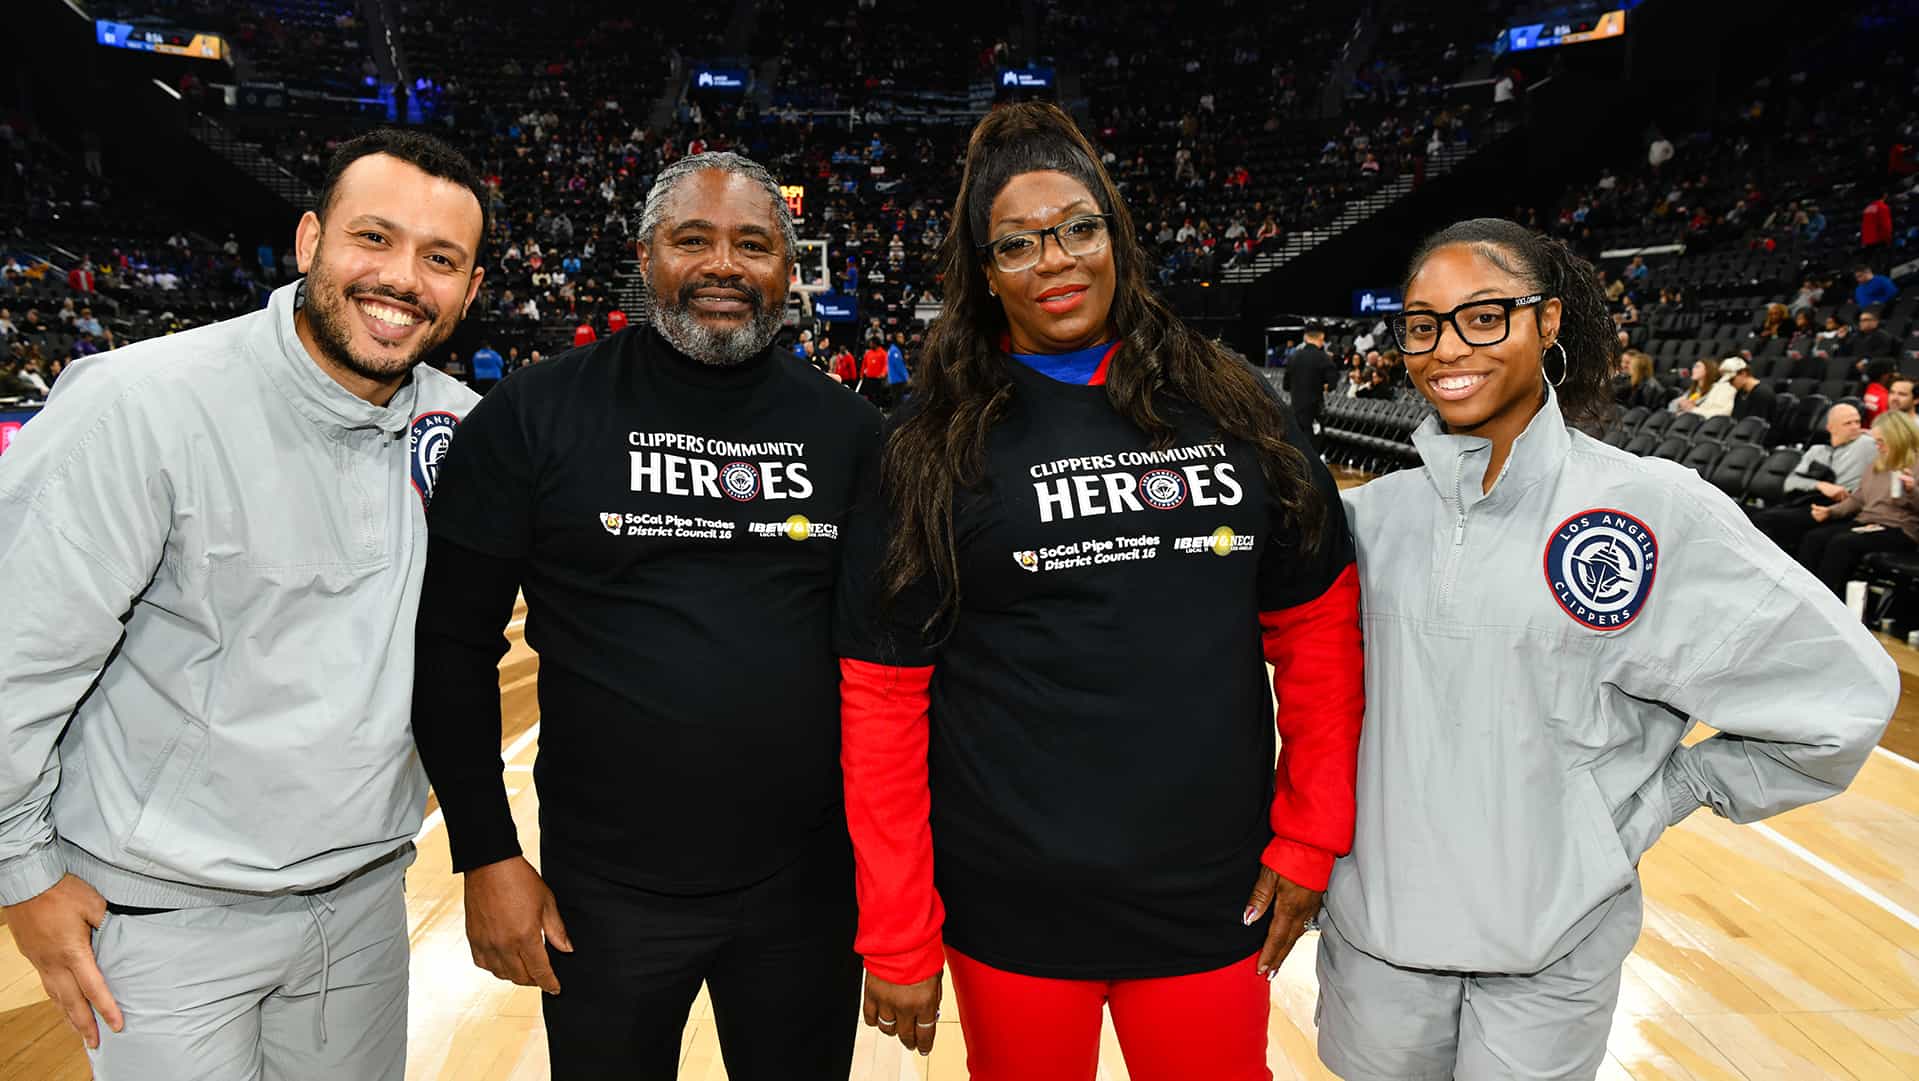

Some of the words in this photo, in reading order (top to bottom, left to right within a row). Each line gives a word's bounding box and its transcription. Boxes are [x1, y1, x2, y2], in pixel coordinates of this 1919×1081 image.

[628, 431, 704, 453] CLIPPERS
[707, 439, 804, 457] COMMUNITY
[1029, 454, 1116, 478] CLIPPERS
[1118, 443, 1227, 465] COMMUNITY
[628, 451, 814, 502] HEROES
[1033, 462, 1243, 523] HEROES
[625, 513, 663, 525] SoCal
[665, 514, 693, 527] Pipe
[694, 517, 735, 530] Trades
[627, 525, 673, 537] District
[675, 527, 718, 539] Council
[719, 530, 732, 539] 16
[748, 522, 792, 533] IBEW
[1039, 543, 1079, 559] SoCal
[1082, 539, 1113, 553] Pipe
[1115, 534, 1160, 549] Trades
[1173, 535, 1219, 550] IBEW
[1560, 517, 1590, 541] LOS
[1602, 515, 1654, 571] ANGELES
[1045, 555, 1092, 571] District
[1094, 548, 1140, 564] Council
[1142, 547, 1156, 559] 16
[1555, 581, 1631, 625] CLIPPERS
